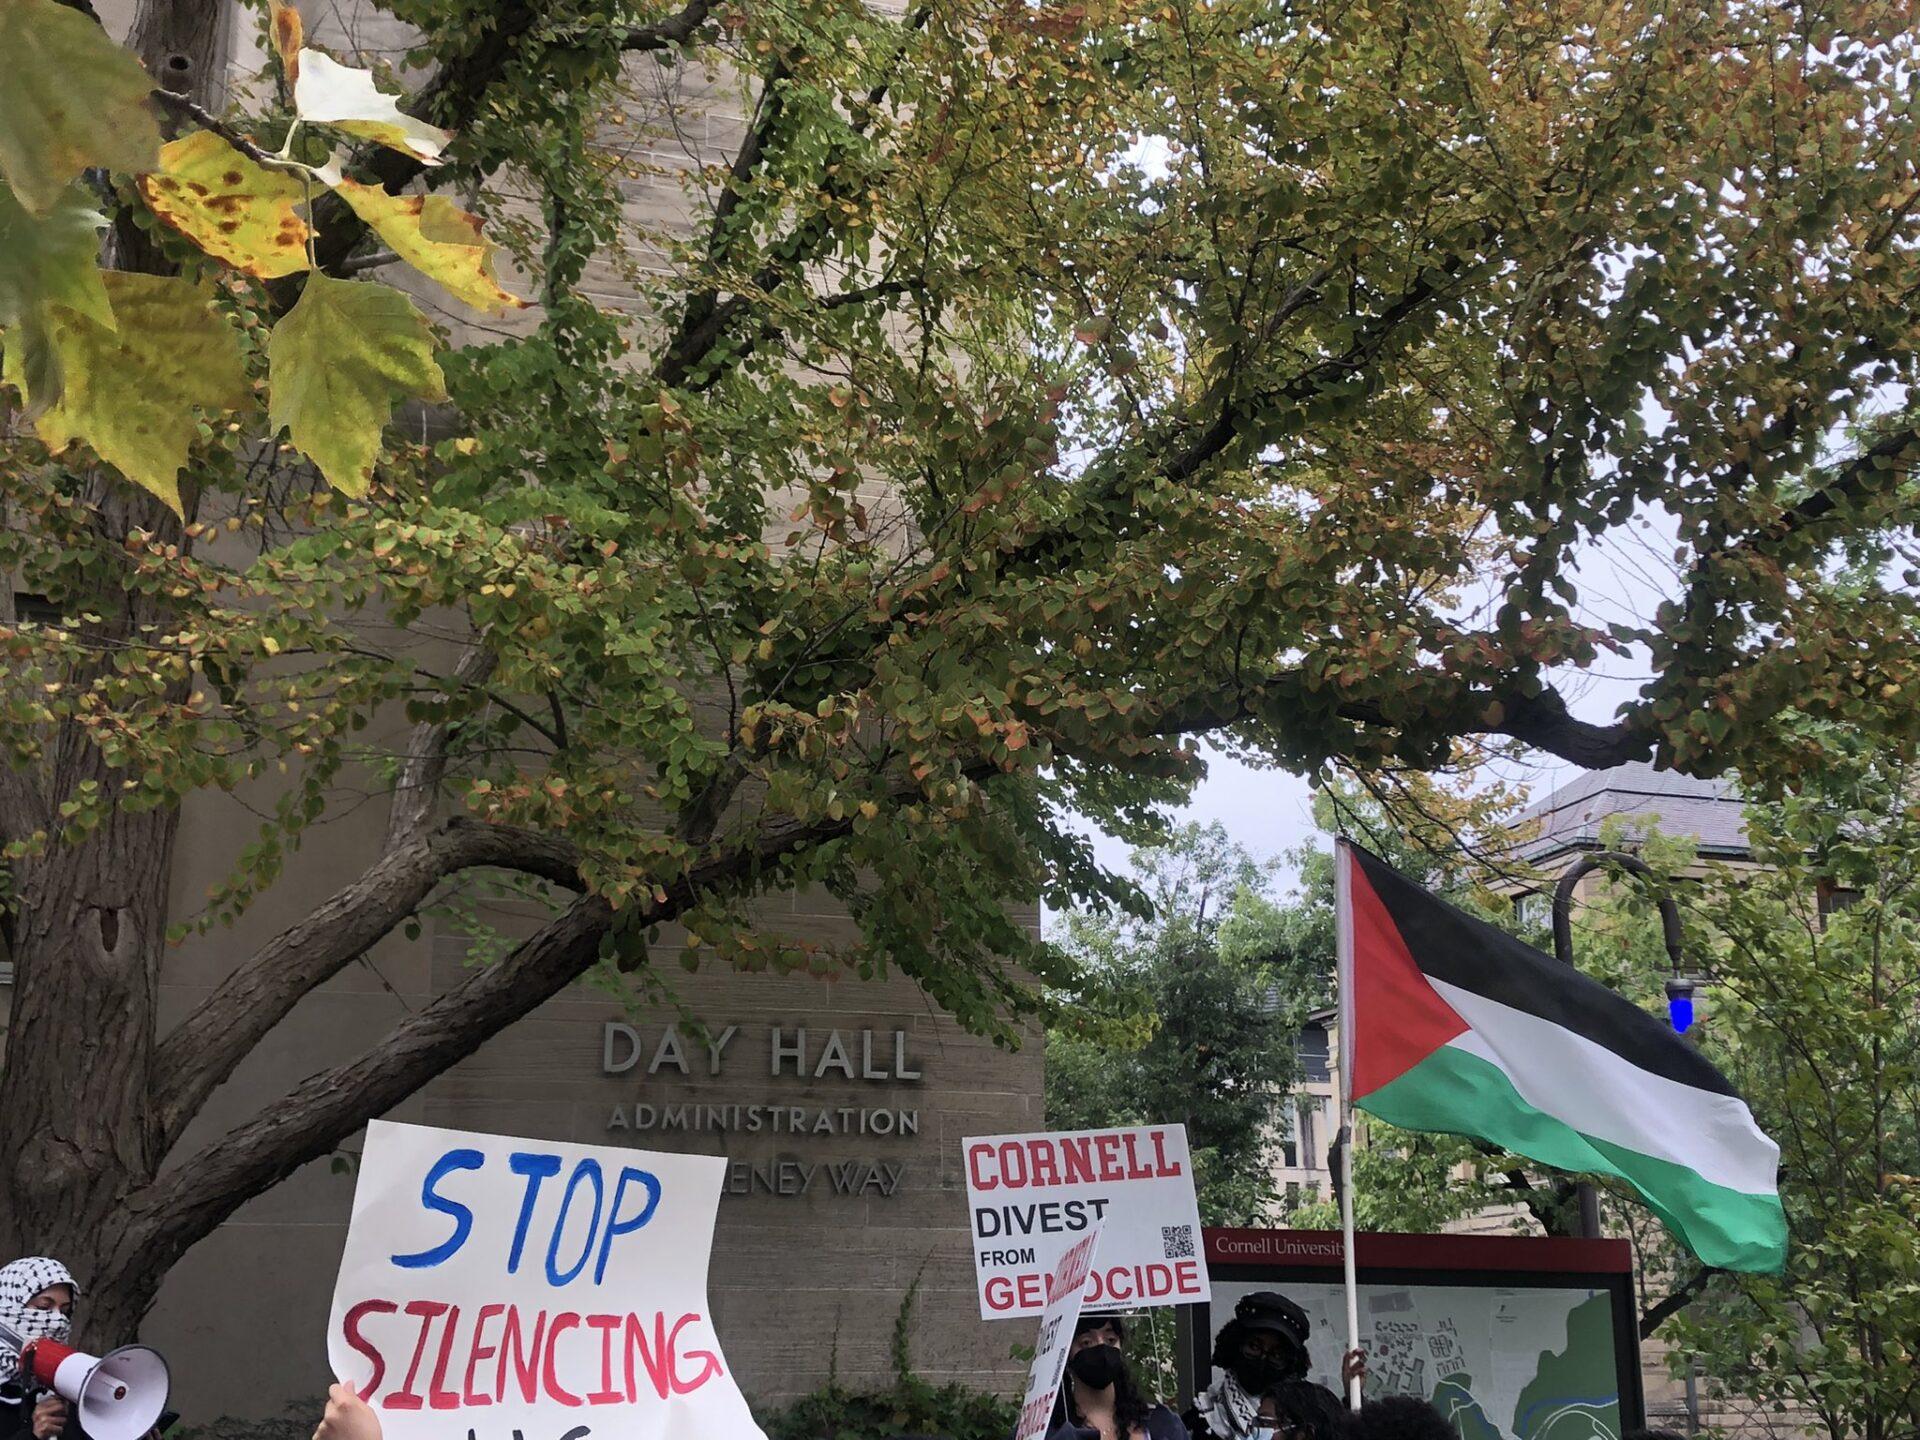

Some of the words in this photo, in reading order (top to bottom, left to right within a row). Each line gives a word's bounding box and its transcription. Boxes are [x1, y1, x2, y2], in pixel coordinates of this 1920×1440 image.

[604, 1022, 738, 1074] DAY
[771, 1027, 921, 1080] HALL
[607, 1103, 918, 1135] ADMINISTRATION
[721, 1160, 818, 1195] ENEY
[826, 1162, 905, 1196] WAY
[968, 1131, 1182, 1191] CORNELL
[390, 1148, 662, 1288] STOP
[975, 1198, 1110, 1238] DIVEST
[980, 1248, 1036, 1268] FROM
[1215, 1236, 1270, 1254] Cornell
[343, 1298, 724, 1410] SILENCING
